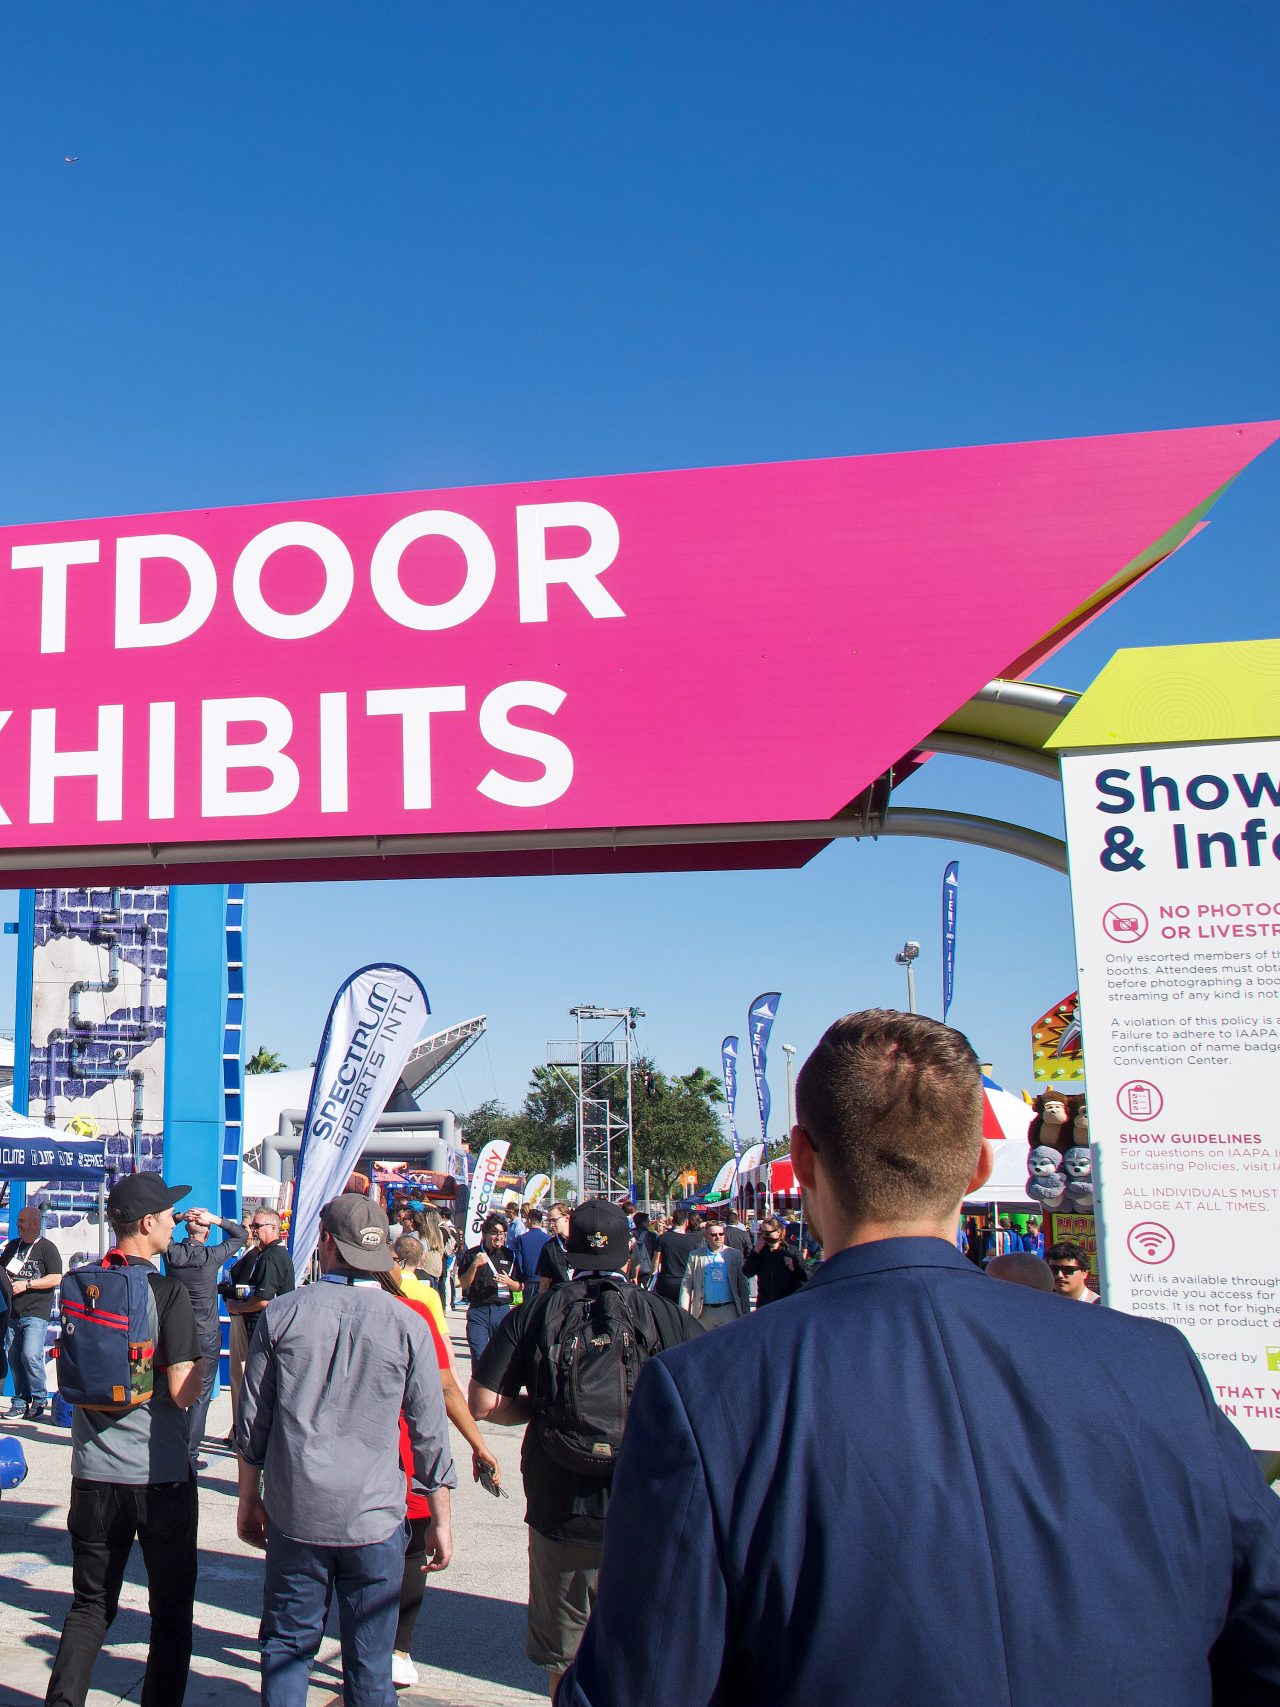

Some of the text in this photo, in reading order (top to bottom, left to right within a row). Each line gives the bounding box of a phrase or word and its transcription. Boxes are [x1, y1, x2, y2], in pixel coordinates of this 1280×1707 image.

[1099, 818, 1280, 872] & Inf
[1160, 905, 1190, 918] NO
[1162, 926, 1191, 939] OR
[1106, 954, 1133, 963] Only
[1137, 952, 1189, 961] escorted
[1194, 951, 1251, 960] members
[1255, 950, 1268, 959] of
[1107, 966, 1151, 975] booths.
[1156, 965, 1217, 974] Attendees
[1222, 965, 1252, 973] must
[1108, 979, 1146, 988] before
[1151, 977, 1241, 988] photographing
[1109, 990, 1278, 1001] streaming of any kind is not
[380, 994, 413, 1042] INTL
[1111, 1016, 1272, 1026] A violation of this policy is
[1112, 1029, 1278, 1039] Failure to adhere to IAAPA
[1113, 1043, 1185, 1052] confiscation
[1190, 1043, 1202, 1051] of
[312, 982, 392, 1141] SPECTRUM
[1114, 1056, 1232, 1065] Convention Center.
[334, 1050, 385, 1150] SPORTS
[1120, 1134, 1262, 1144] SHOW GUIDELINES
[1120, 1148, 1141, 1157] For
[1145, 1148, 1204, 1158] questions
[1228, 1148, 1270, 1157] IAAPA
[1121, 1161, 1184, 1171] Suitcasing
[1189, 1161, 1239, 1172] Policies,
[1243, 1162, 1269, 1171] visit
[472, 1149, 502, 1233] eyecandy
[1124, 1188, 1279, 1198] ALL INDIVIDUALS MUST
[1124, 1201, 1270, 1211] BADGE AT ALL TIMES.
[1130, 1273, 1154, 1283] Wifi
[1159, 1274, 1167, 1283] is
[1172, 1275, 1227, 1285] available
[1131, 1288, 1178, 1297] provide
[1210, 1291, 1252, 1299] access
[1257, 1290, 1275, 1300] for
[1132, 1302, 1168, 1311] posts.
[1173, 1302, 1180, 1311] It
[1185, 1302, 1194, 1311] is
[1199, 1303, 1220, 1312] not
[1224, 1303, 1242, 1312] for
[1217, 1316, 1269, 1327] product
[1241, 1352, 1257, 1363] by
[1216, 1386, 1264, 1399] THAT
[1219, 1404, 1237, 1416] N
